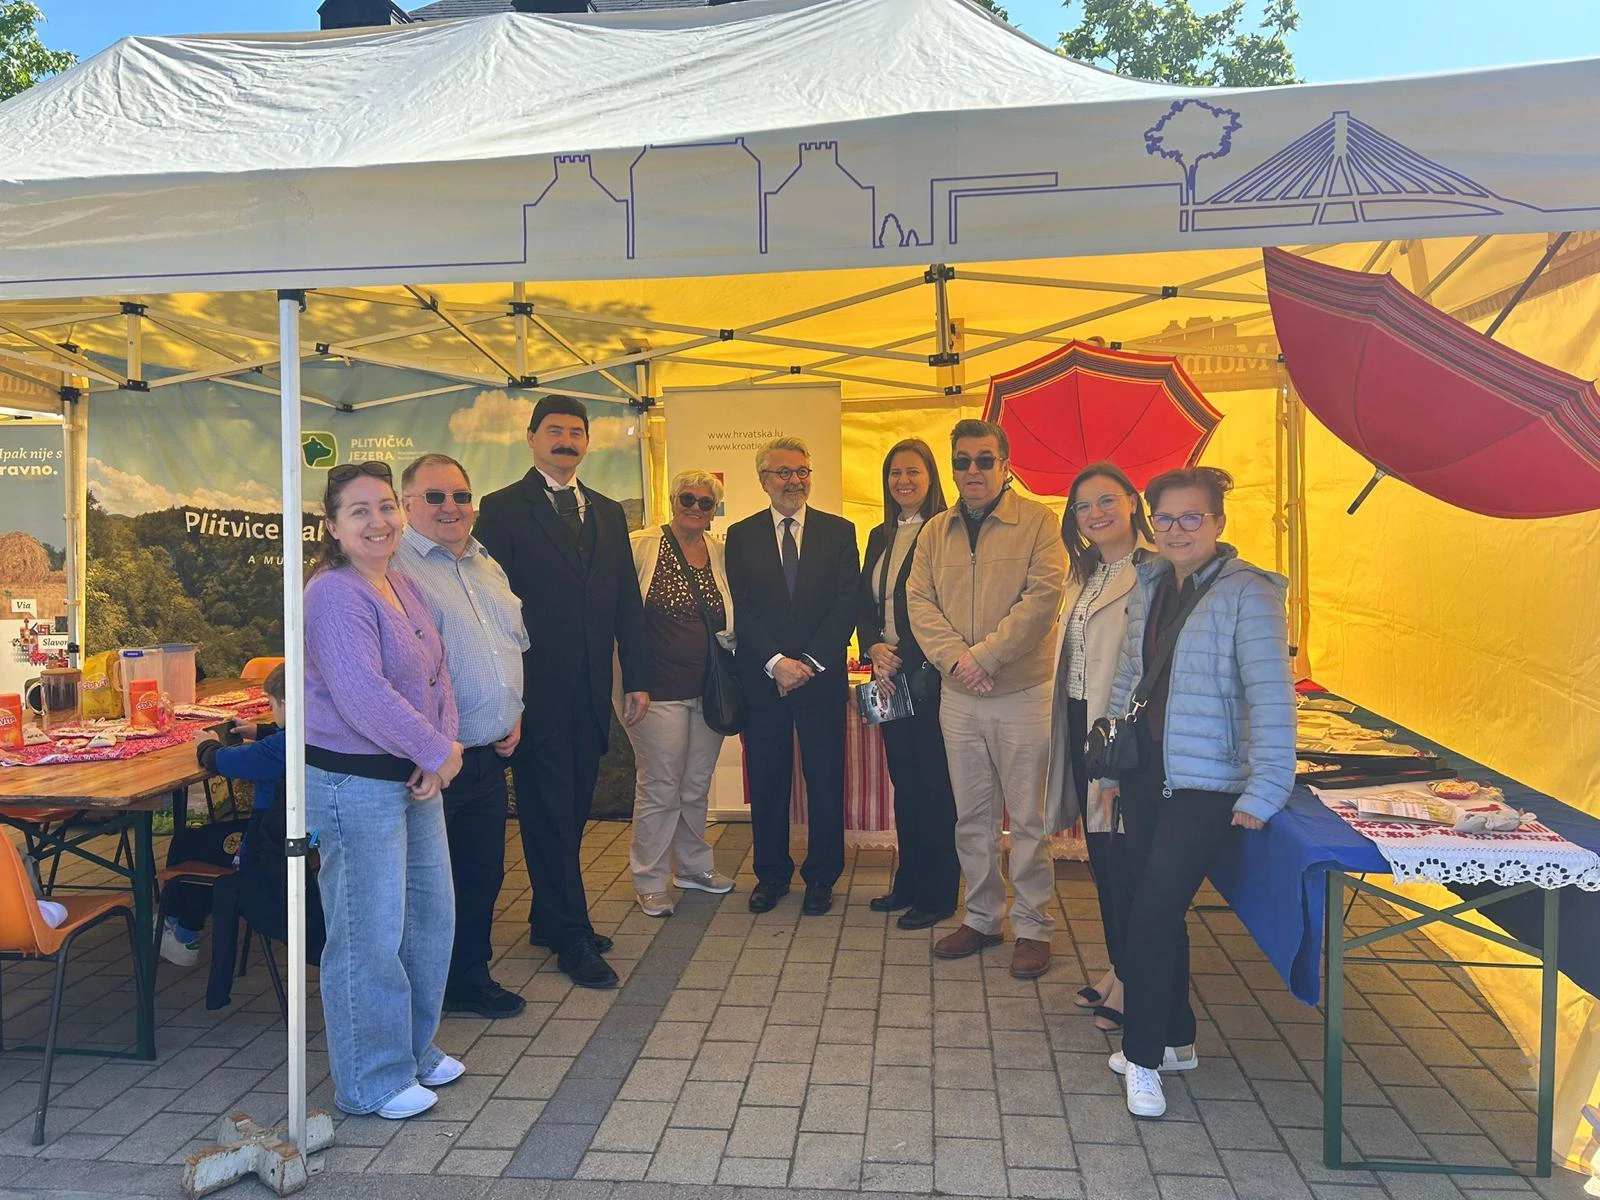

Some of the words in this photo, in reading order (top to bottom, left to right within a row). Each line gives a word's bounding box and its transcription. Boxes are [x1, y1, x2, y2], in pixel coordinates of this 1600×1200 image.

[707, 429, 784, 439] www.hrvatska.lu
[350, 434, 414, 449] PLITVIČKA
[707, 442, 763, 451] www.kroatie
[30, 447, 54, 462] nije
[55, 449, 64, 459] s
[347, 451, 395, 463] JEZERA
[185, 511, 280, 540] Plitvice
[302, 520, 325, 542] ak
[247, 555, 256, 564] A
[16, 601, 31, 609] Via
